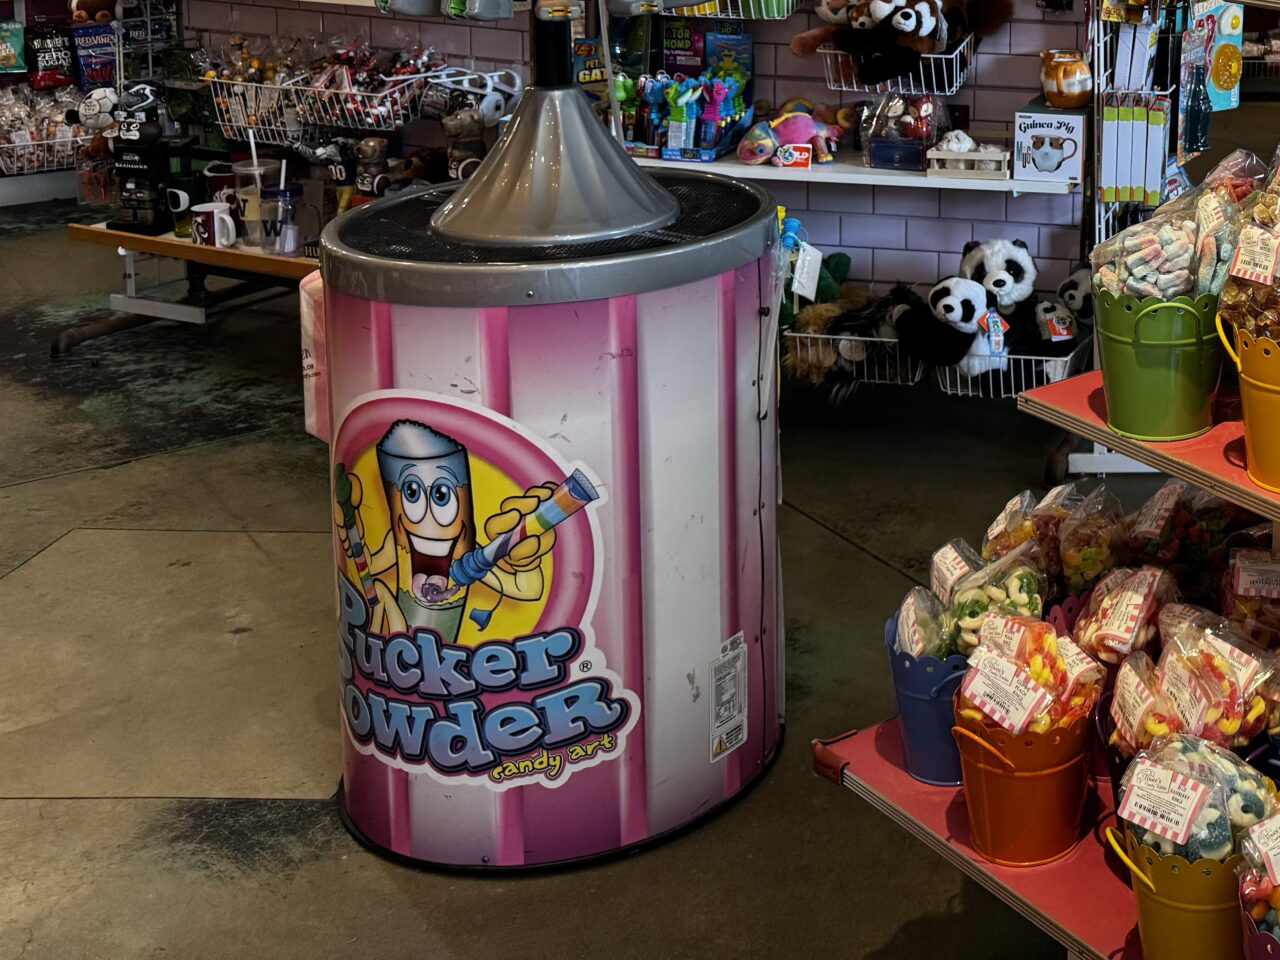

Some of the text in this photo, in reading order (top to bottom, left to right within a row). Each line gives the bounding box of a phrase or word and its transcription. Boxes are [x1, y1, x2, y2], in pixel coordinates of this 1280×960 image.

[74, 34, 118, 48] RED VINES
[37, 49, 71, 61] ZERO
[37, 56, 72, 67] SUGAR
[1018, 120, 1075, 134] Guinea Pig
[261, 219, 283, 237] W
[338, 573, 580, 698] Pucker
[492, 735, 615, 778] candy art
